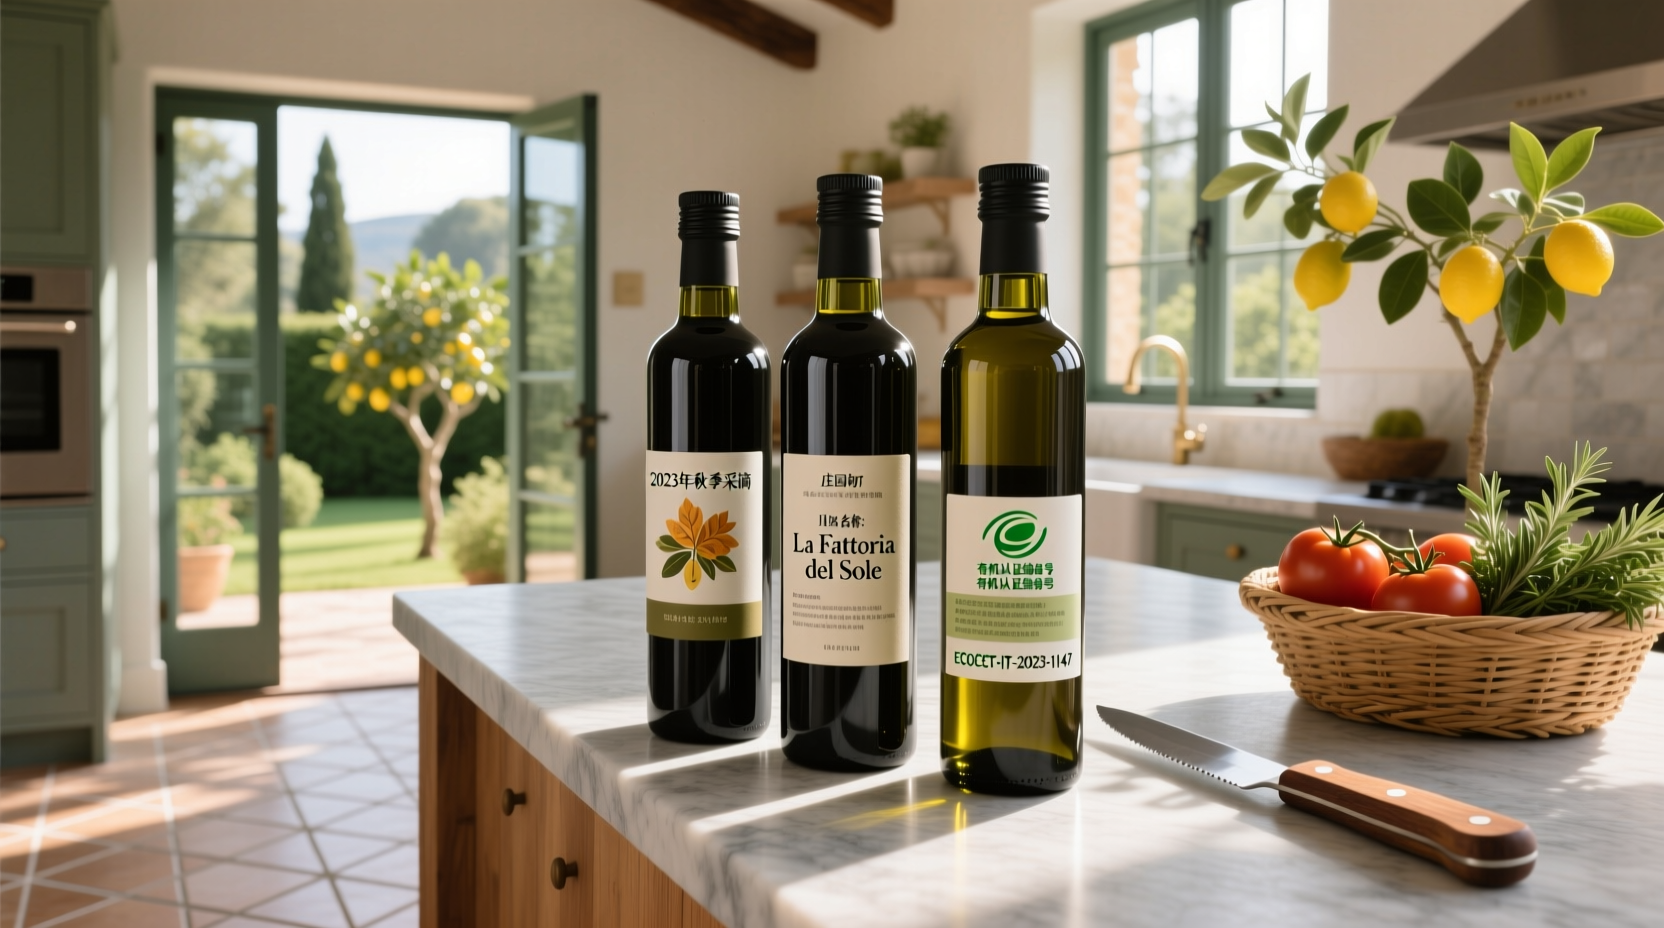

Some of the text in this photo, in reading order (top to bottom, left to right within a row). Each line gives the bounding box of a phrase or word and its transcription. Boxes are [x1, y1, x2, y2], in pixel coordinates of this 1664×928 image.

[793, 532, 896, 555] La Fattoria
[805, 558, 883, 581] del Sole
